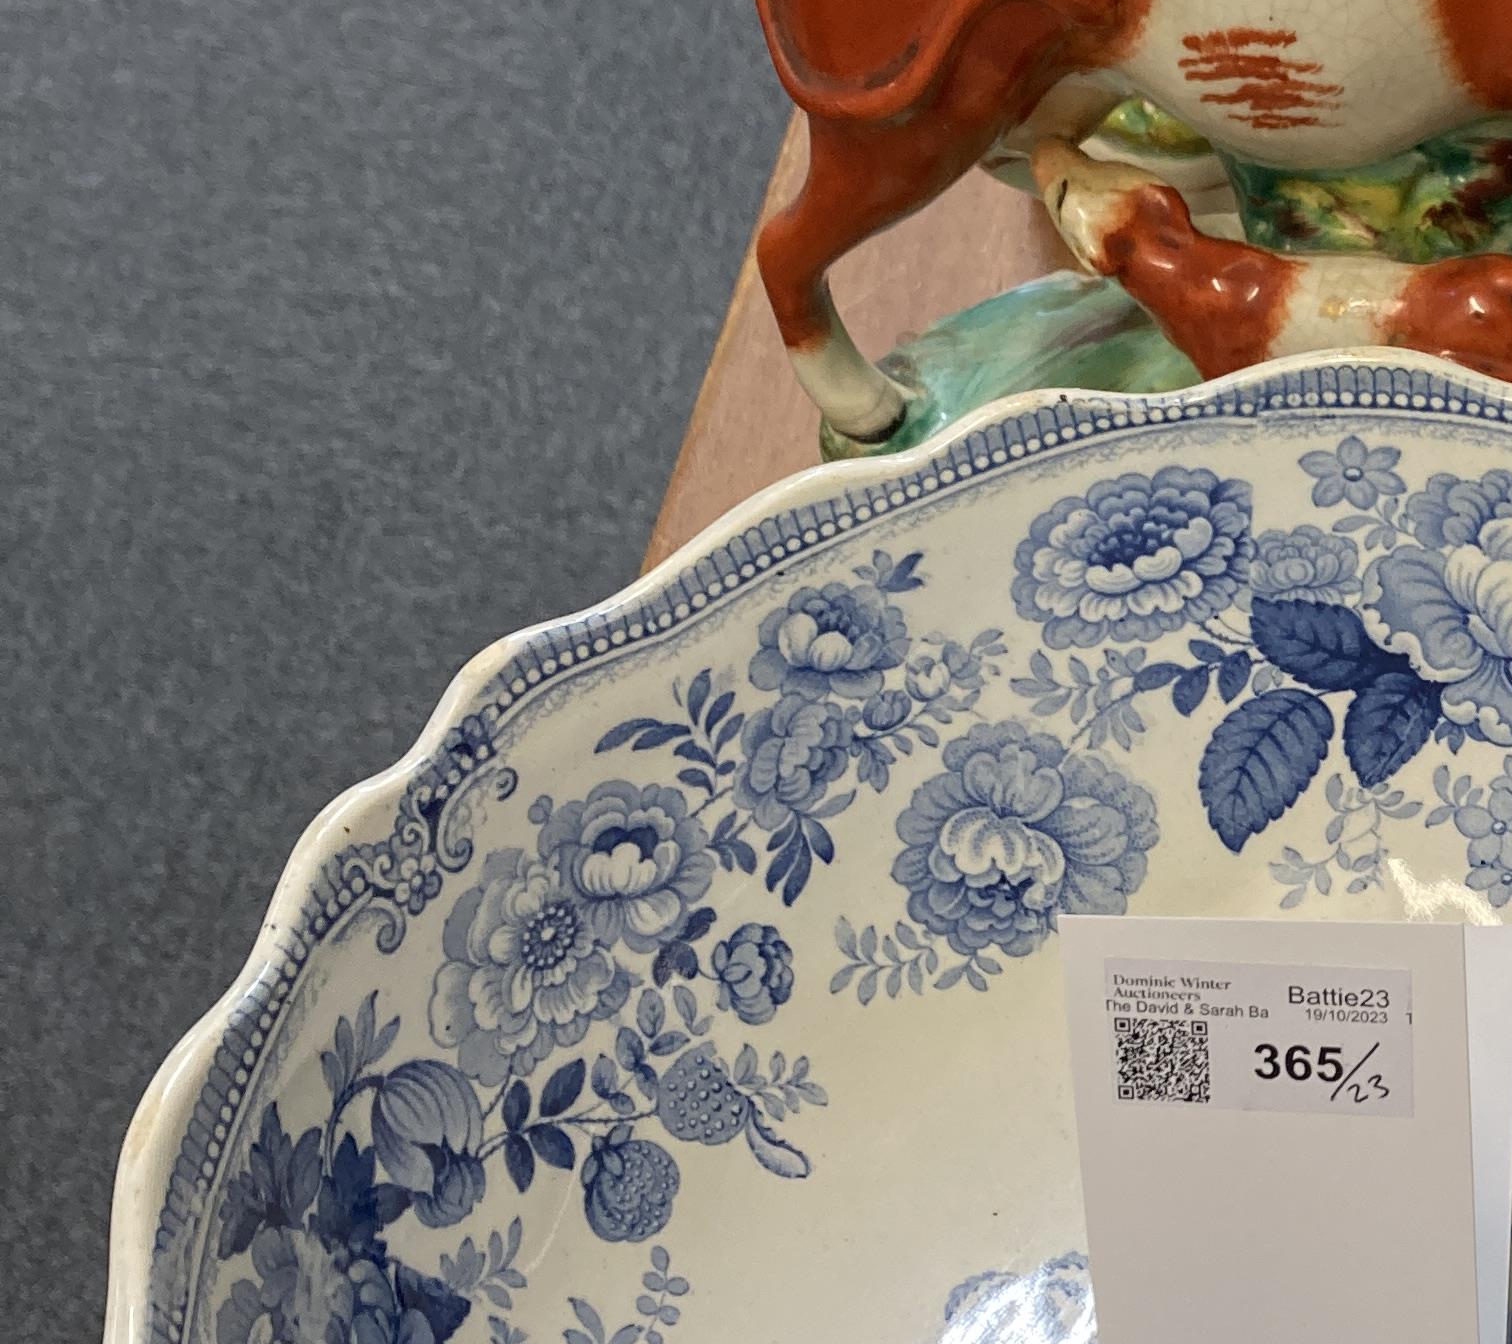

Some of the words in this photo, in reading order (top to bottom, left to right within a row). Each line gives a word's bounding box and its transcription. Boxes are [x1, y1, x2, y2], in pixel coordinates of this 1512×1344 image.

[1113, 974, 1176, 988] Dominic
[1180, 977, 1232, 990] Winter
[1113, 987, 1201, 1001] Auctioneers
[1288, 985, 1390, 1008] Battie23
[1136, 1000, 1178, 1014] David
[1184, 1002, 1194, 1015] &
[1200, 1003, 1244, 1017] Sarah
[1249, 1005, 1270, 1018] Ba
[1305, 1008, 1389, 1024] 19/10/2023
